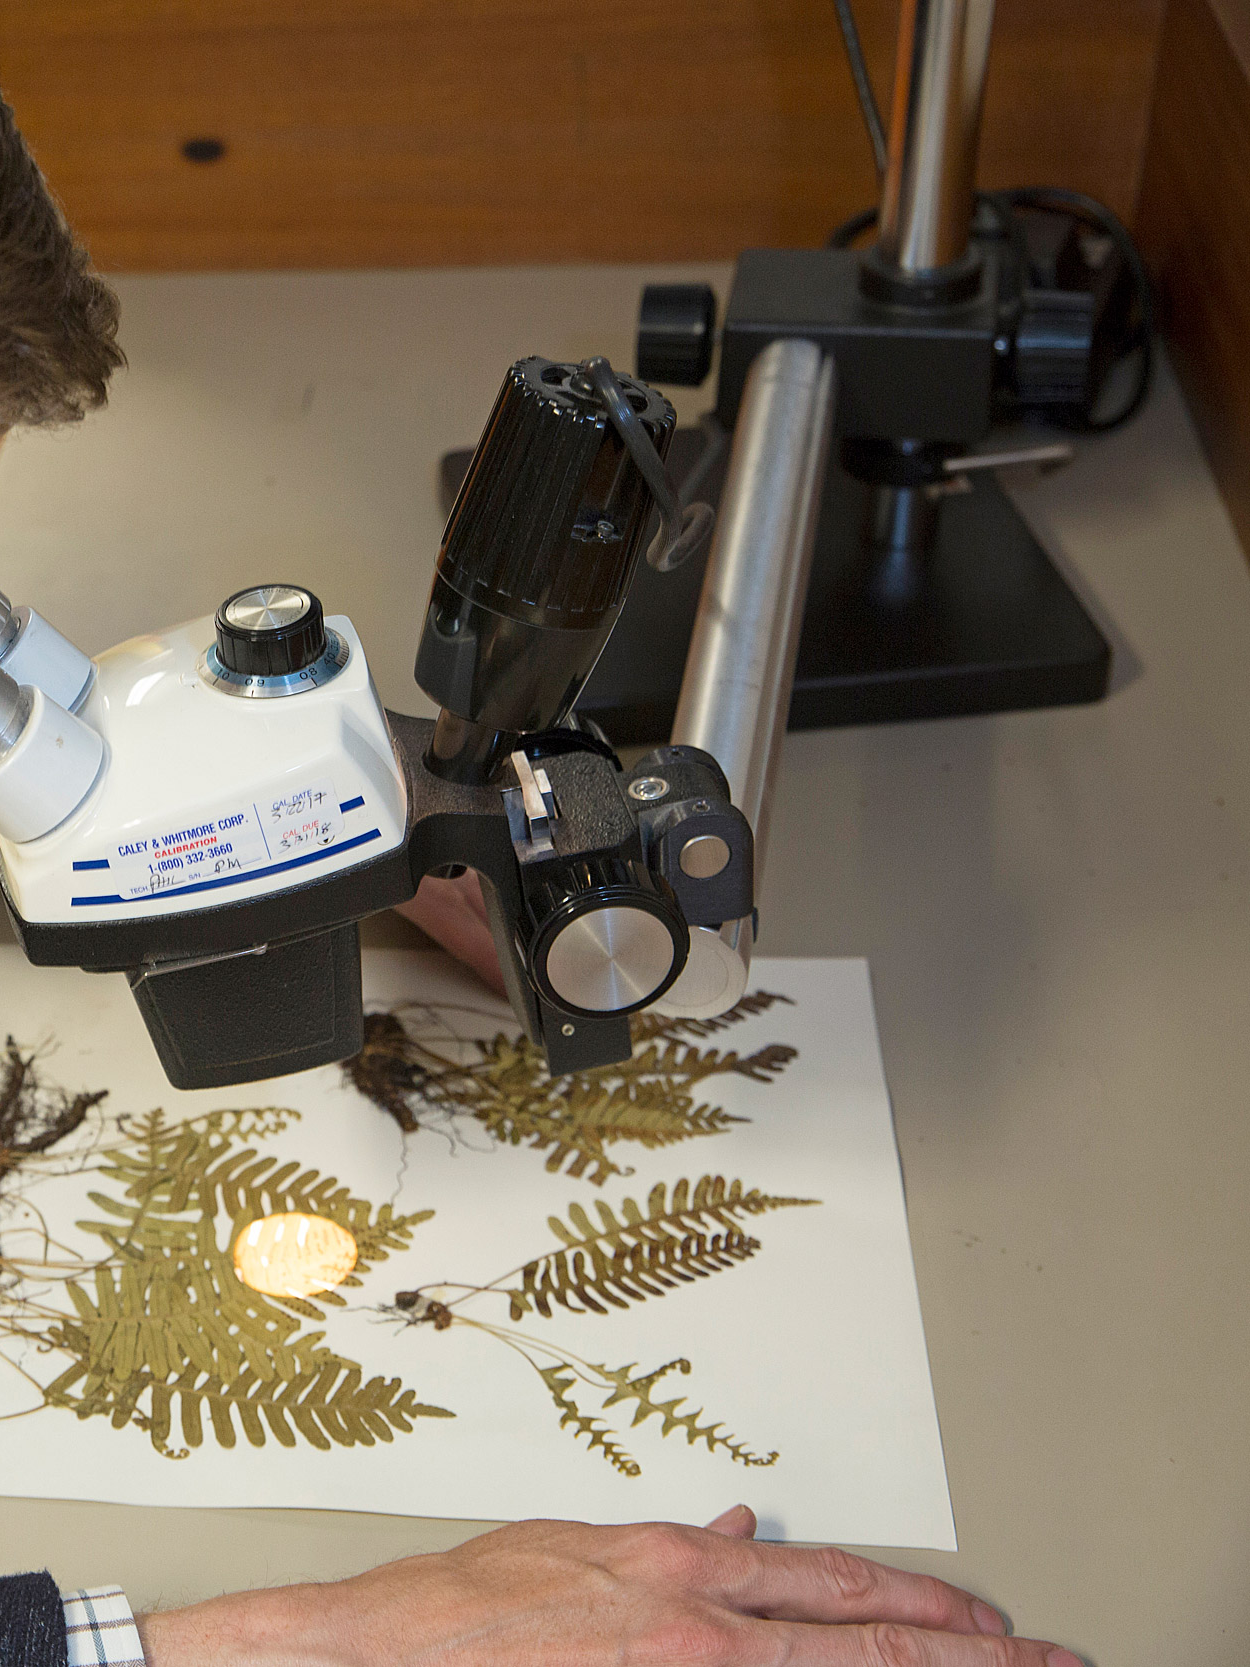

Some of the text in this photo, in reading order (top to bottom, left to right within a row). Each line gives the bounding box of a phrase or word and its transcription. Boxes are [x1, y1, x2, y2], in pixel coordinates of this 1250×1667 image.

[292, 789, 312, 803] DATE
[117, 813, 249, 857] CALEY & WHITMORE CORP.
[302, 819, 319, 832] DUE
[147, 842, 233, 874] 1-(800) 332-3660
[154, 836, 218, 859] CALIBRATION
